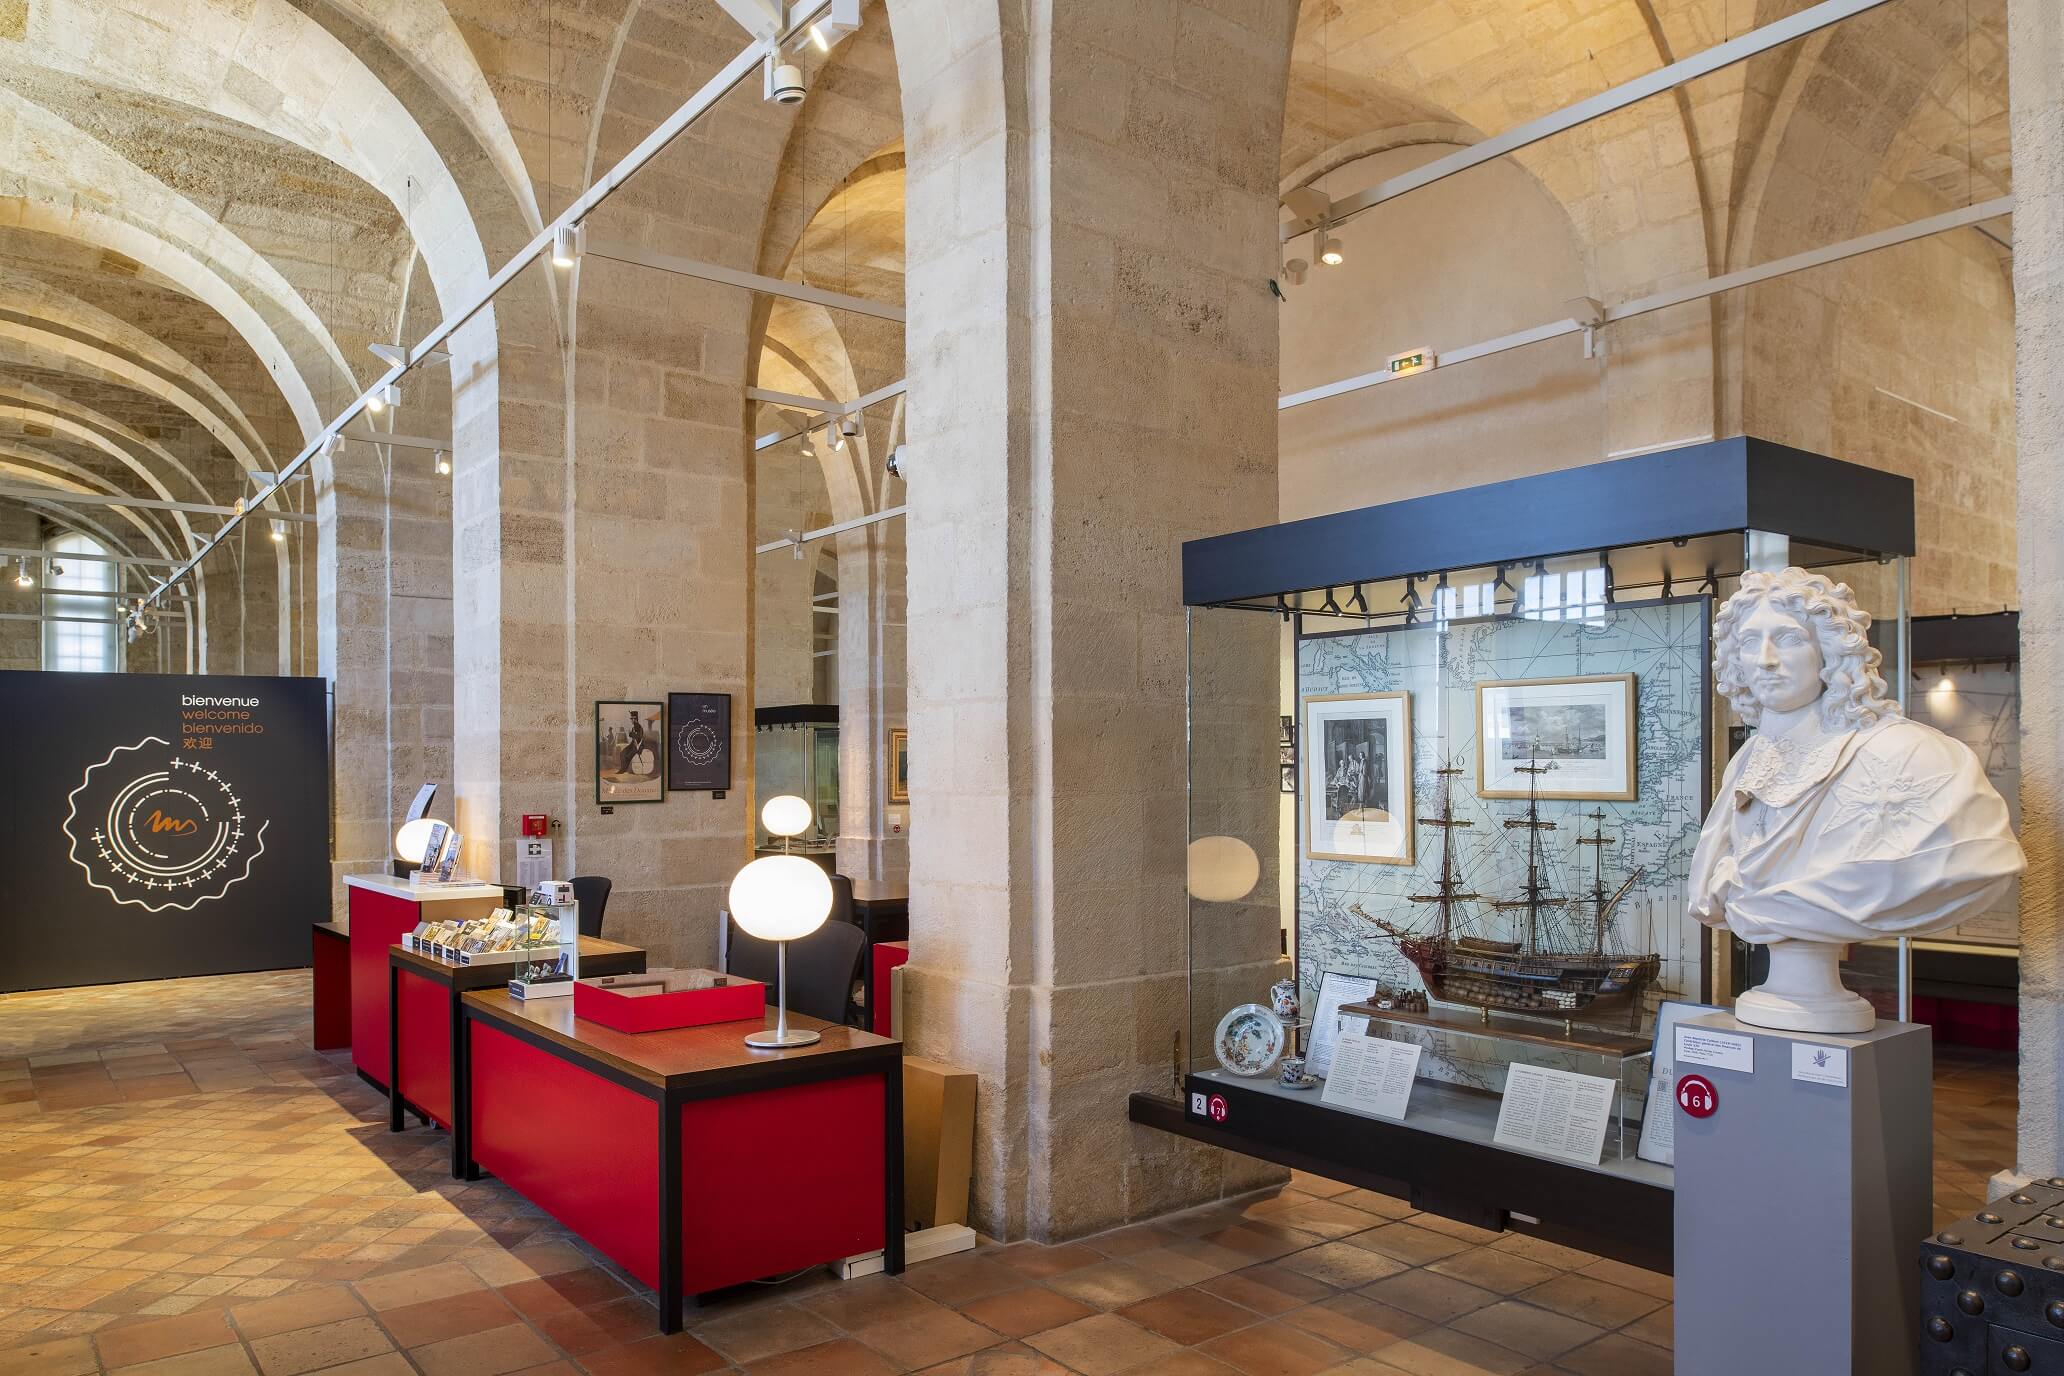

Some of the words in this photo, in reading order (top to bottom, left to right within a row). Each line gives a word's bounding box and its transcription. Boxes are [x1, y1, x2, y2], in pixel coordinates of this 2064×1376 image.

[182, 694, 260, 707] bienvenue
[182, 708, 250, 720] welcome
[182, 722, 264, 734] bienvenido
[183, 736, 213, 749] 欢迎
[1196, 1097, 1202, 1110] 2
[1692, 1095, 1701, 1108] 6
